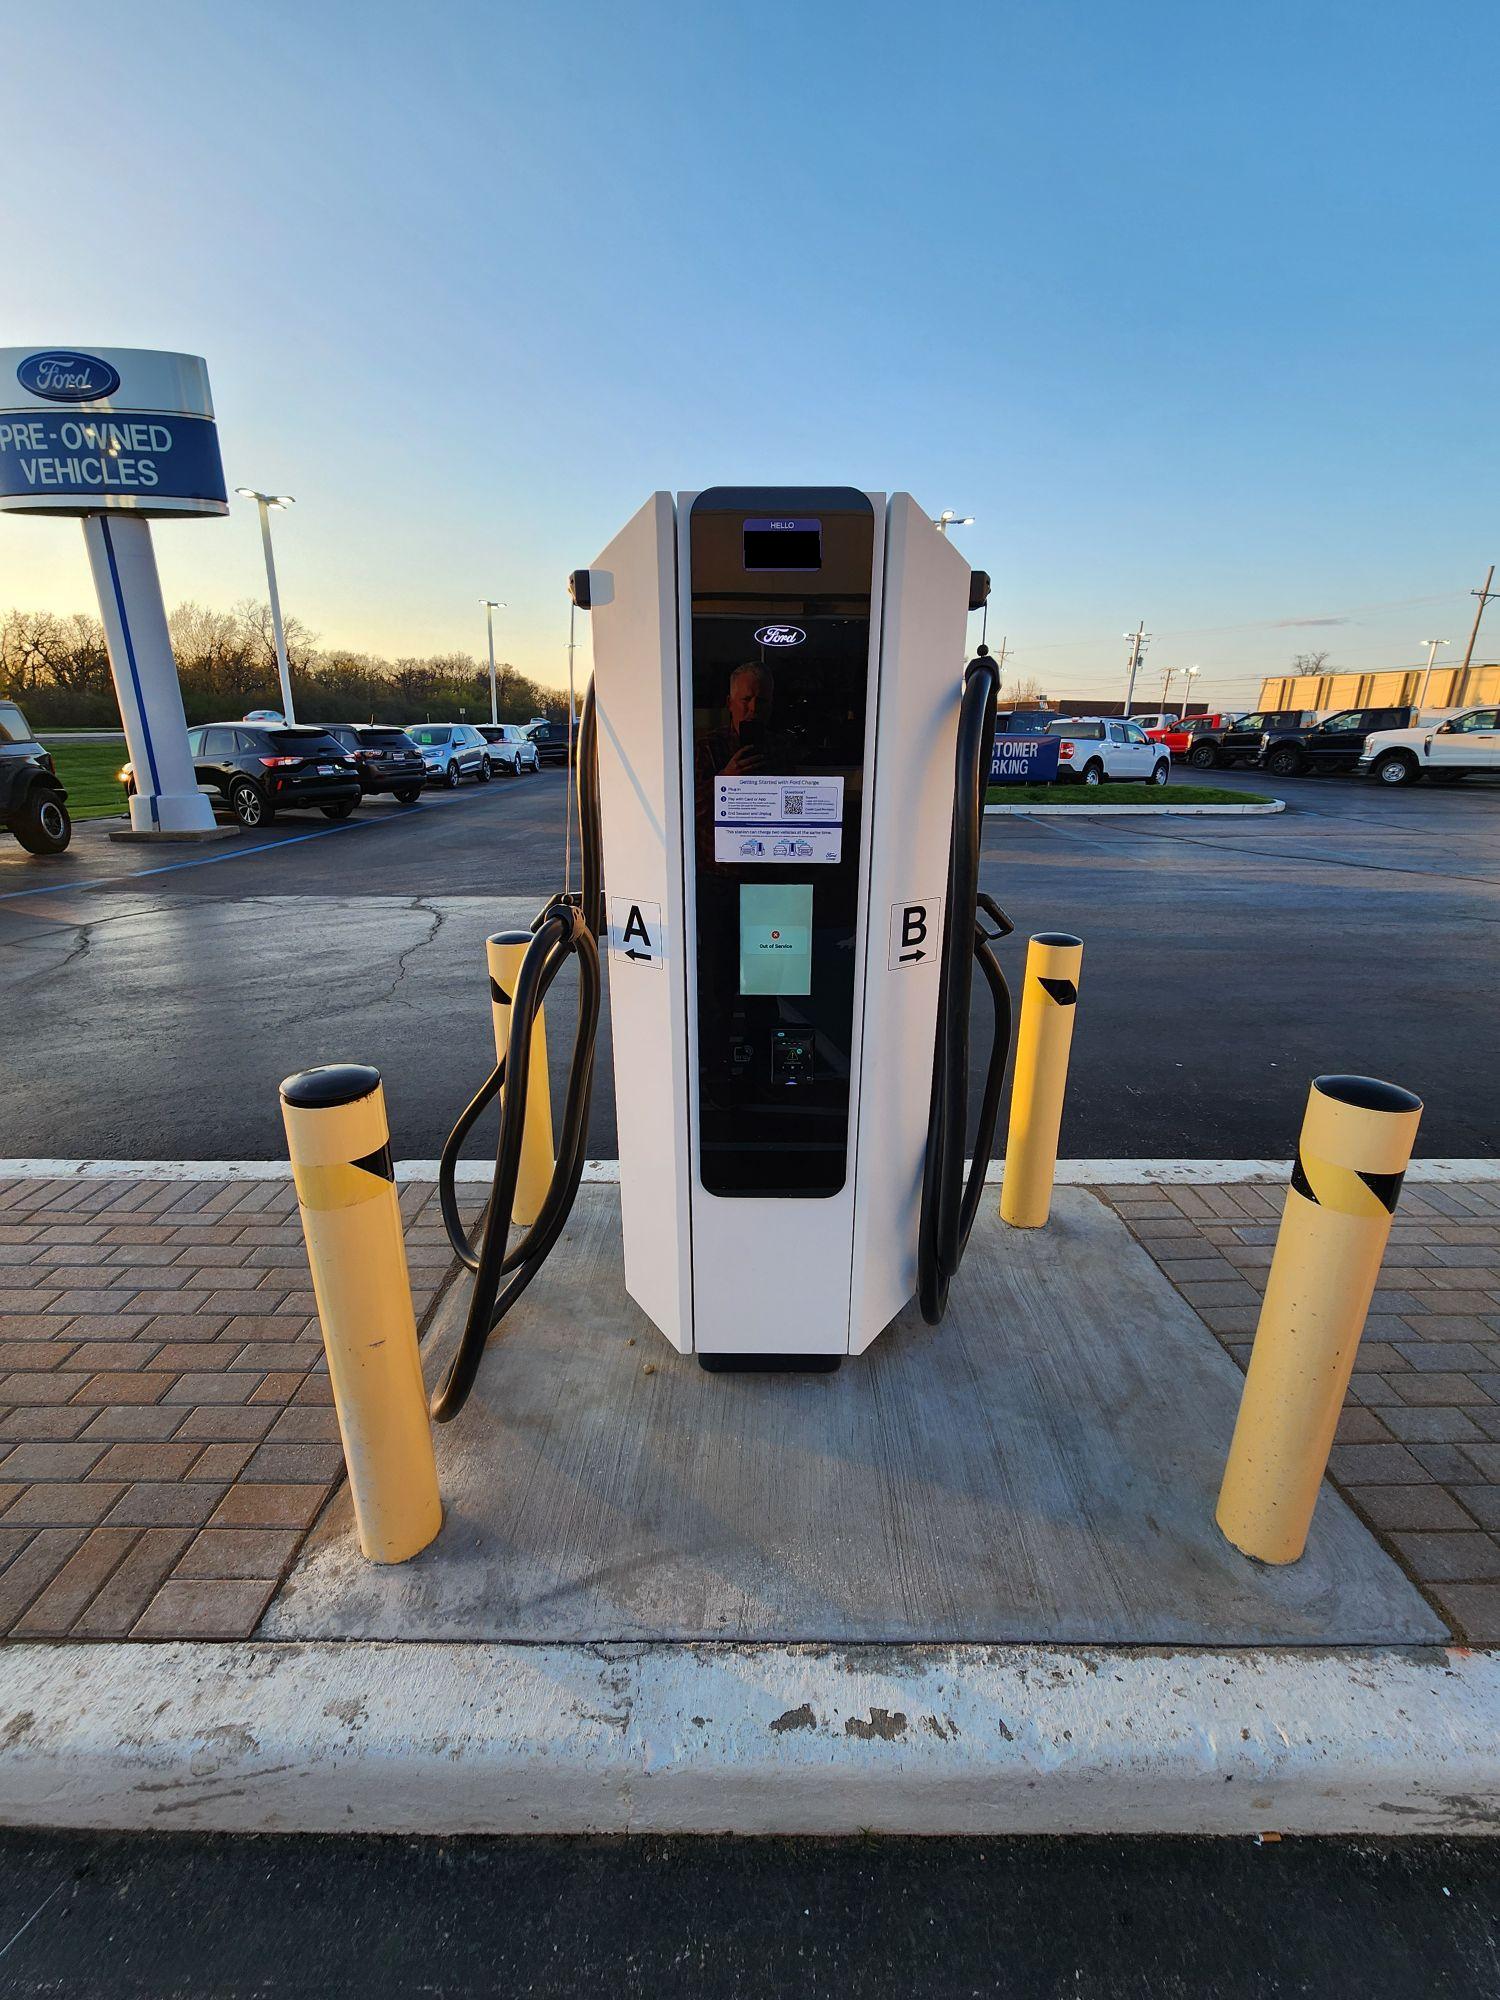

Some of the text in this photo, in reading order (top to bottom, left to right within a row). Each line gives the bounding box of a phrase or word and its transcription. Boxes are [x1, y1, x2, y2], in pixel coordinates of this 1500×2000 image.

[36, 360, 92, 389] Ford
[0, 422, 172, 452] PRE-OWNED
[20, 457, 159, 487] VEHICLES
[770, 521, 795, 529] HELLO
[763, 627, 797, 643] Ford
[622, 905, 652, 947] A
[901, 905, 928, 948] B
